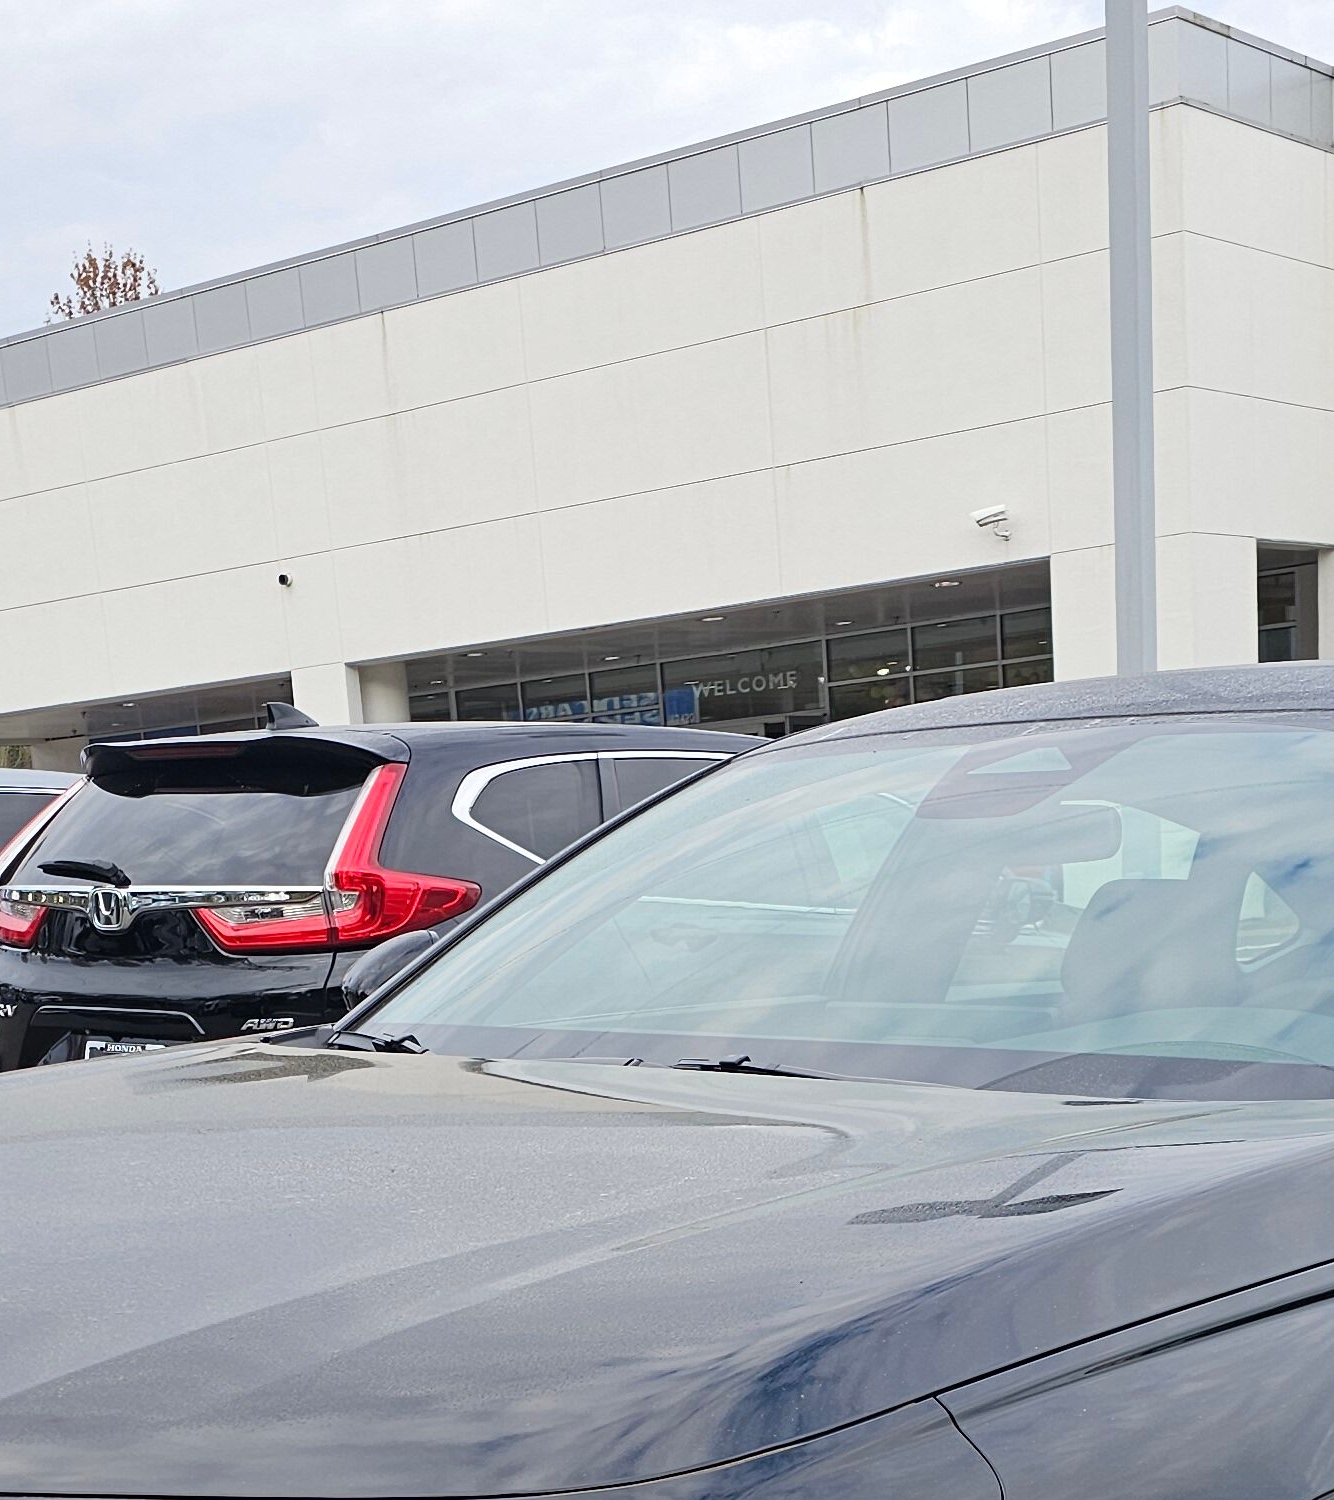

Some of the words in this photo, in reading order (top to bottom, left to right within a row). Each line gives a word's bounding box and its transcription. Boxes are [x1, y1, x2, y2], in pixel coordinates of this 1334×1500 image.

[693, 671, 798, 698] WELCOME
[240, 1017, 295, 1031] AWD
[106, 1044, 143, 1053] HONDA
